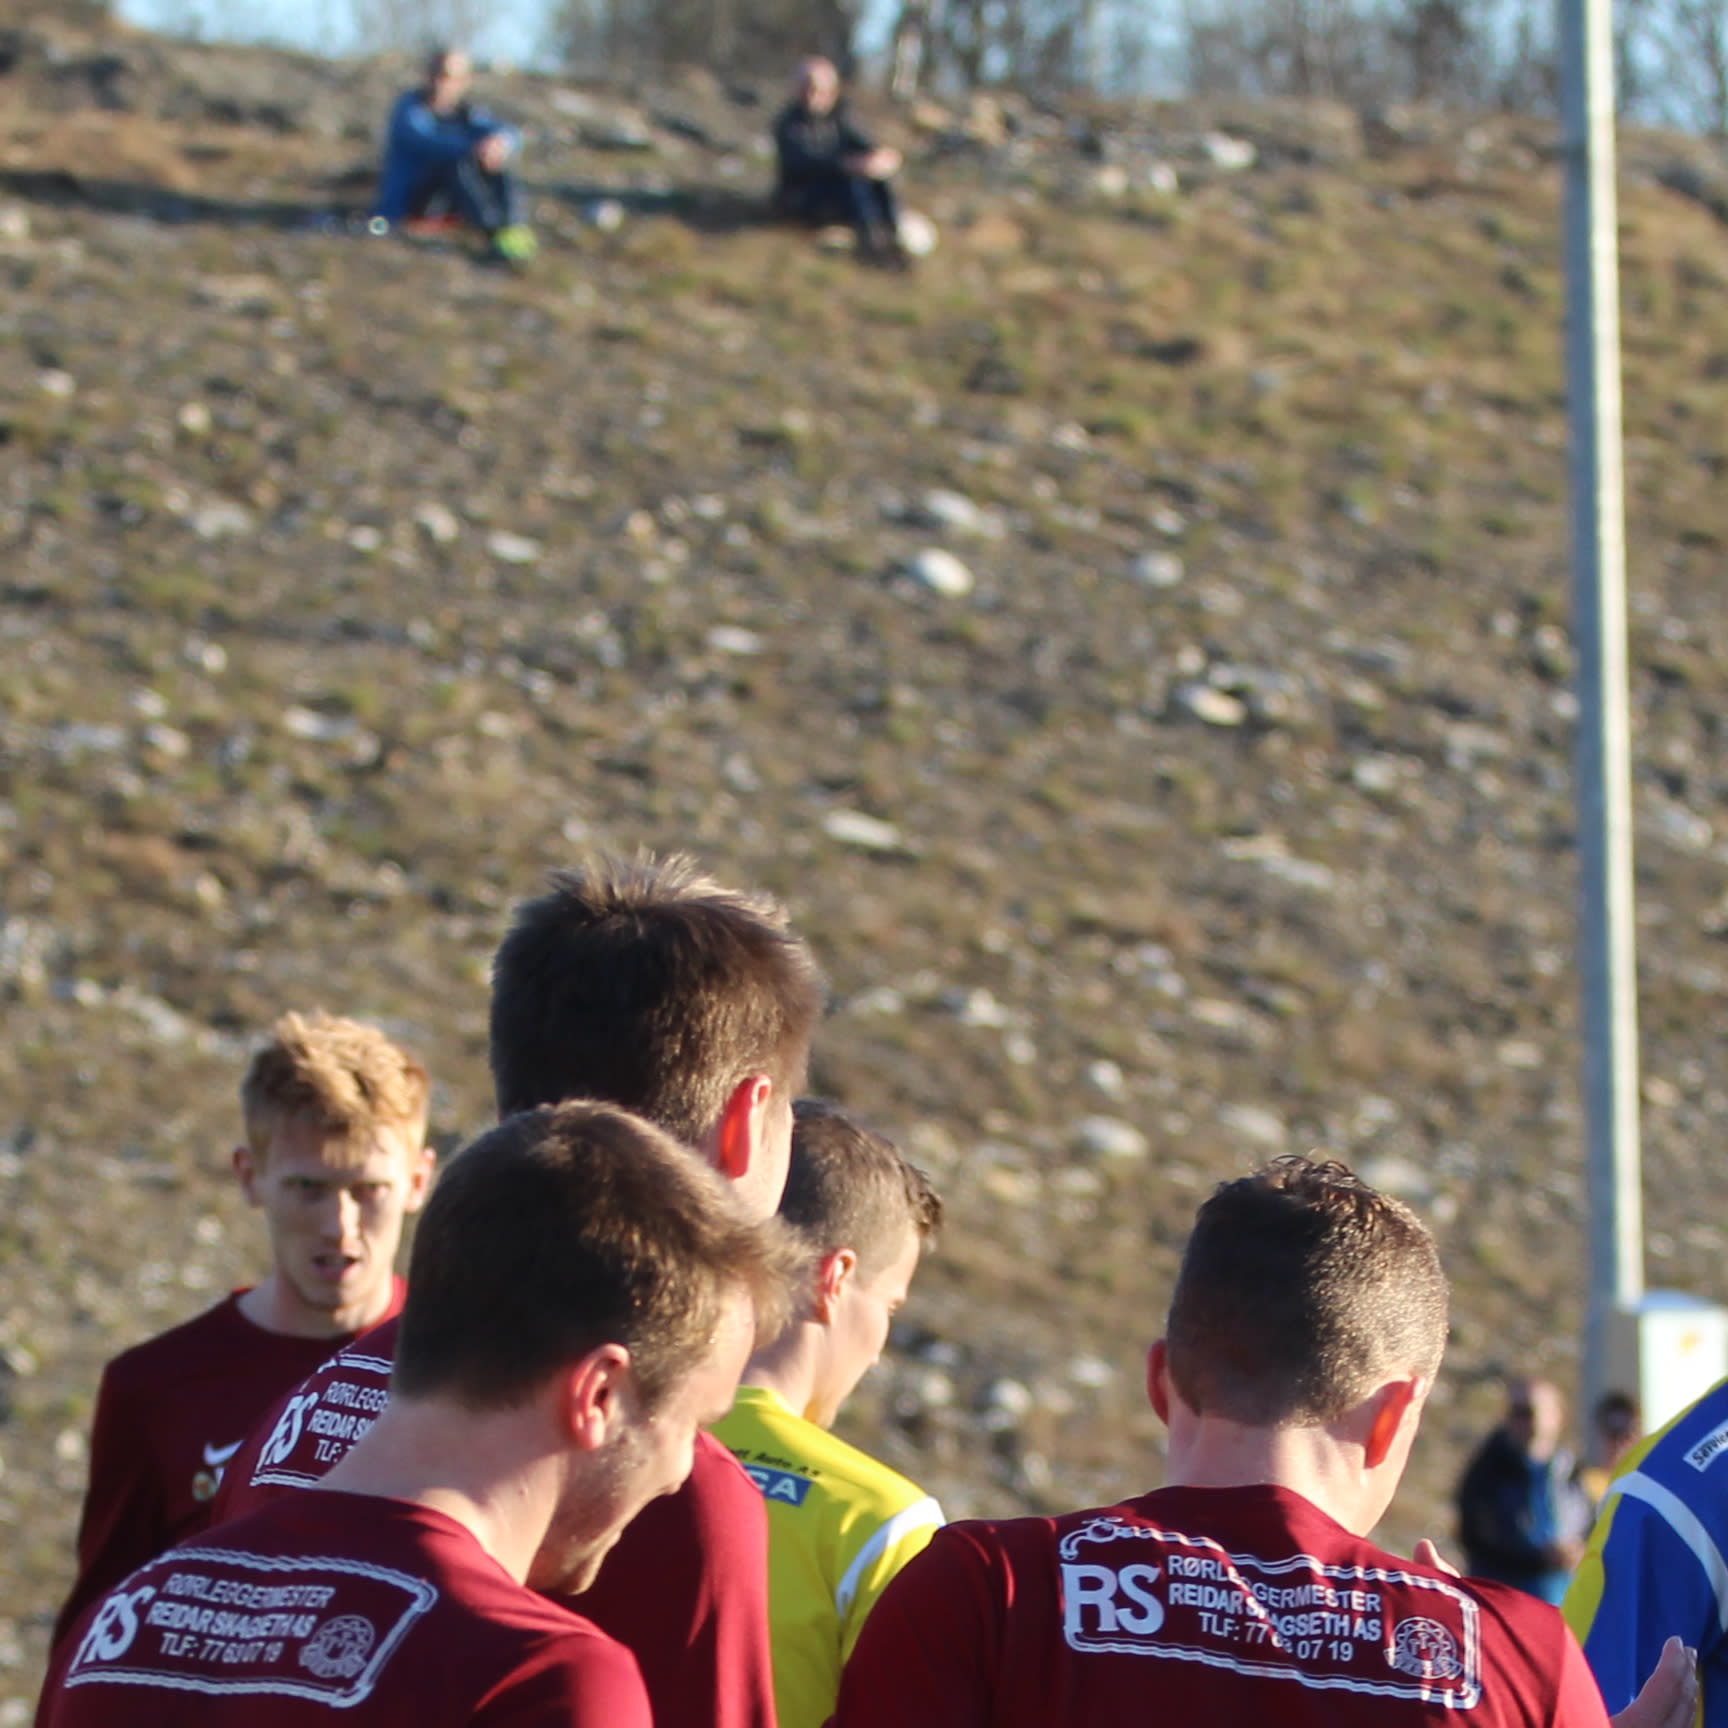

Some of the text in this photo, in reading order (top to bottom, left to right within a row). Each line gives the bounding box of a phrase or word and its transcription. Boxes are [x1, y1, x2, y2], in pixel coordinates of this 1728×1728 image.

[1061, 1563, 1165, 1635] RS
[1168, 1554, 1383, 1613] RØRLGERMESTER
[1169, 1583, 1382, 1641] REIDAR SAGSETH AS
[1198, 1611, 1240, 1639] TLF:
[1244, 1621, 1270, 1643] 77
[1297, 1640, 1324, 1660] 07
[1328, 1640, 1354, 1662] 19
